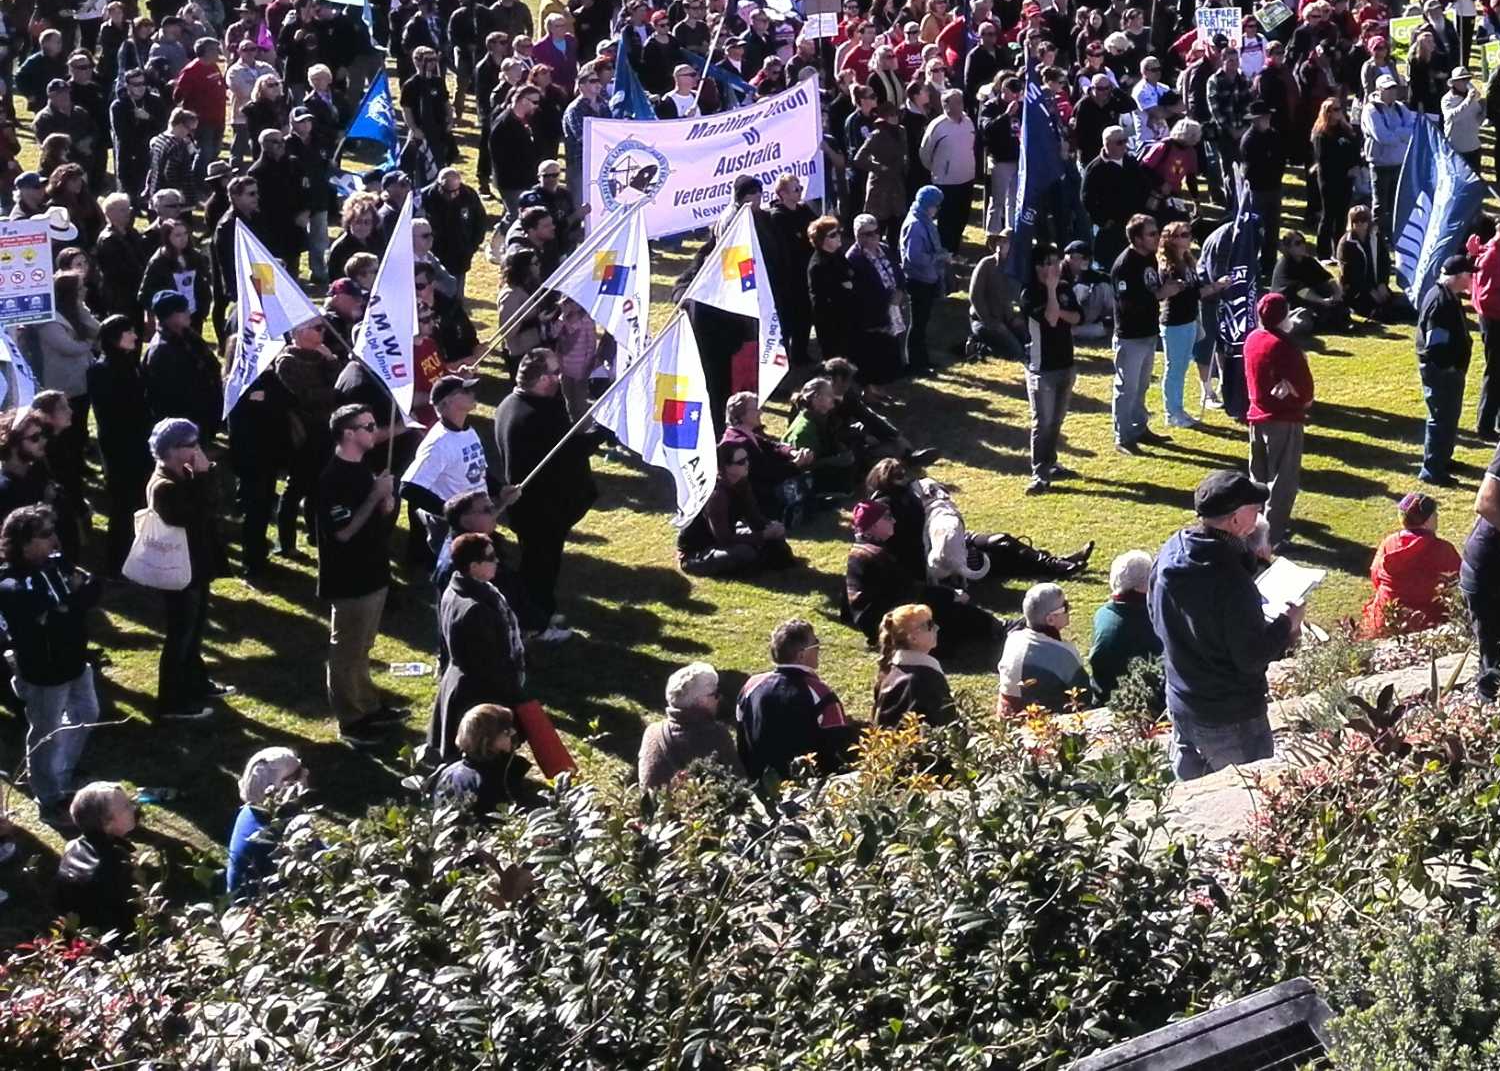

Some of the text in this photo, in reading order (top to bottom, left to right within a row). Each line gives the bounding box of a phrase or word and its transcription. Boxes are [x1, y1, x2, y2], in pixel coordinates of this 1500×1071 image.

[1220, 18, 1239, 28] THE
[686, 87, 809, 141] Maritime Union
[714, 142, 782, 177] Australia
[673, 159, 817, 207] Veterans sociation
[369, 294, 407, 379] AMWU
[759, 337, 777, 365] Union
[374, 351, 392, 380] Union
